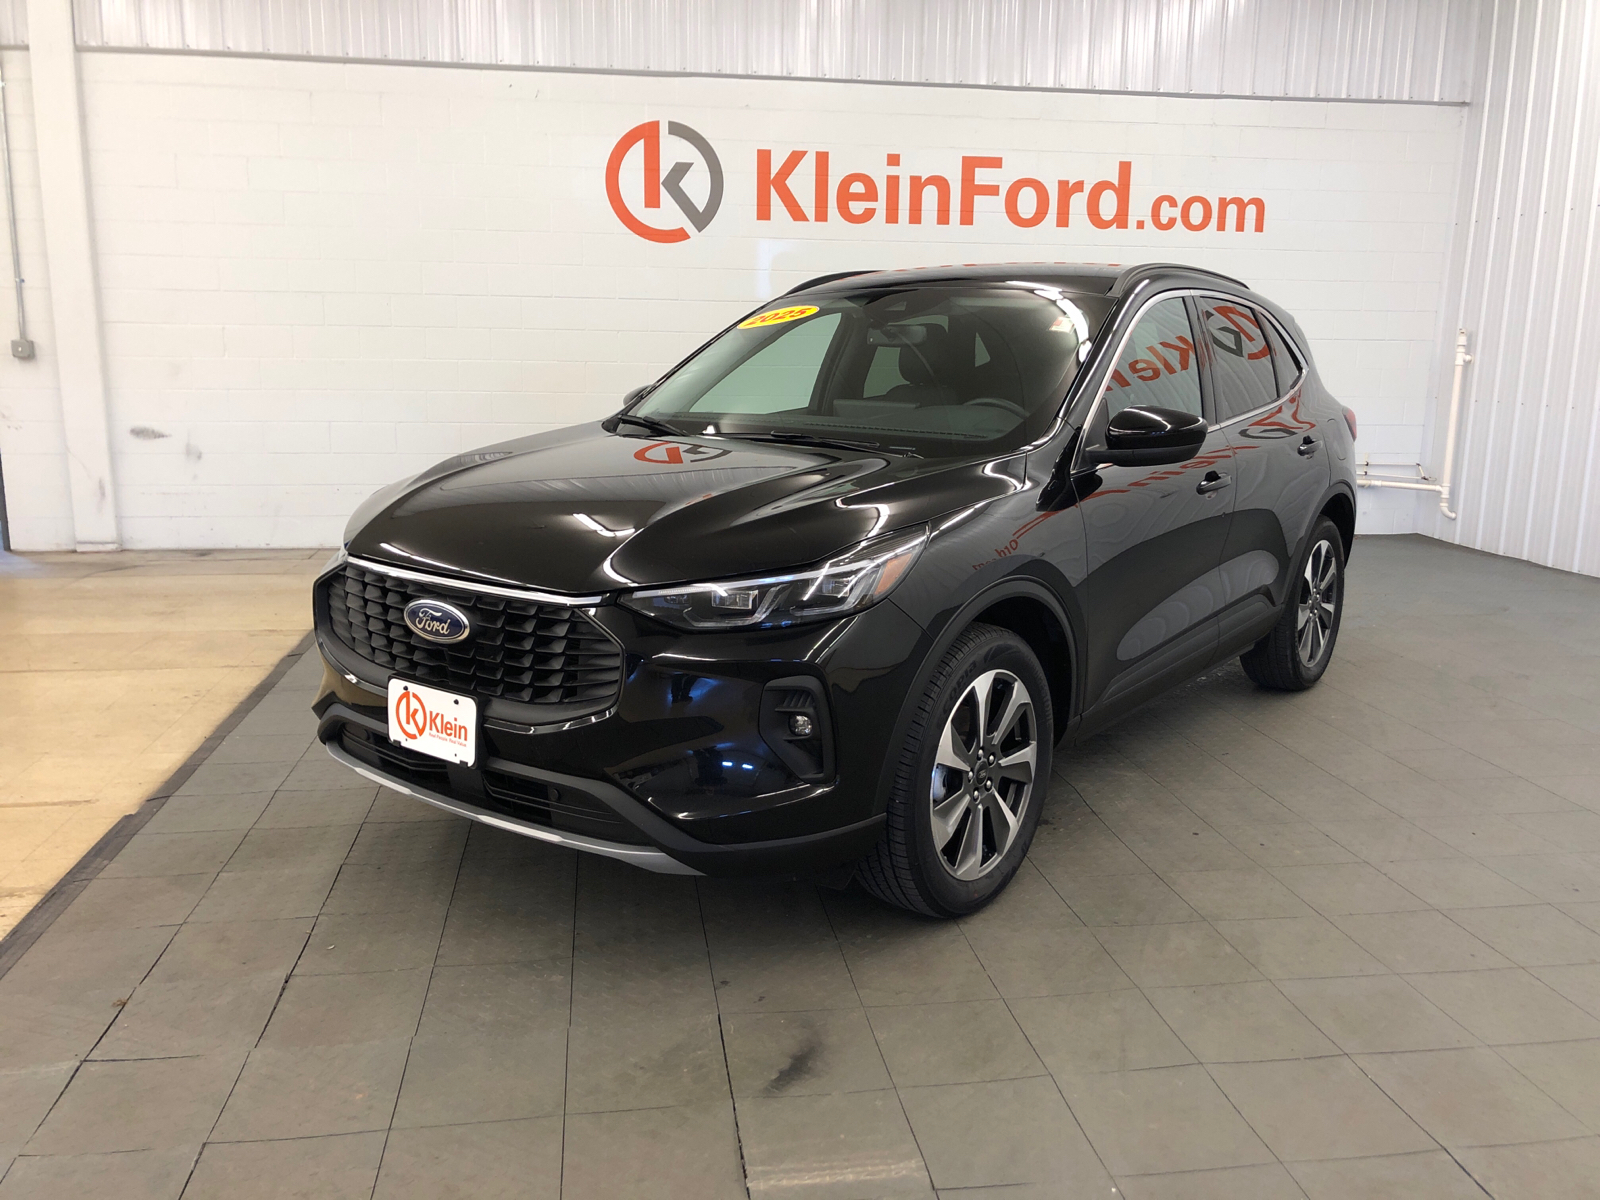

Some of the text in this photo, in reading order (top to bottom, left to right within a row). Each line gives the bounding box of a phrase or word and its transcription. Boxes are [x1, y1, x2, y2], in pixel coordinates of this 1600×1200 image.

[755, 148, 1266, 234] KleinFord.com
[742, 306, 813, 327] 2025
[415, 607, 451, 635] Ford
[429, 710, 468, 742] Klein
